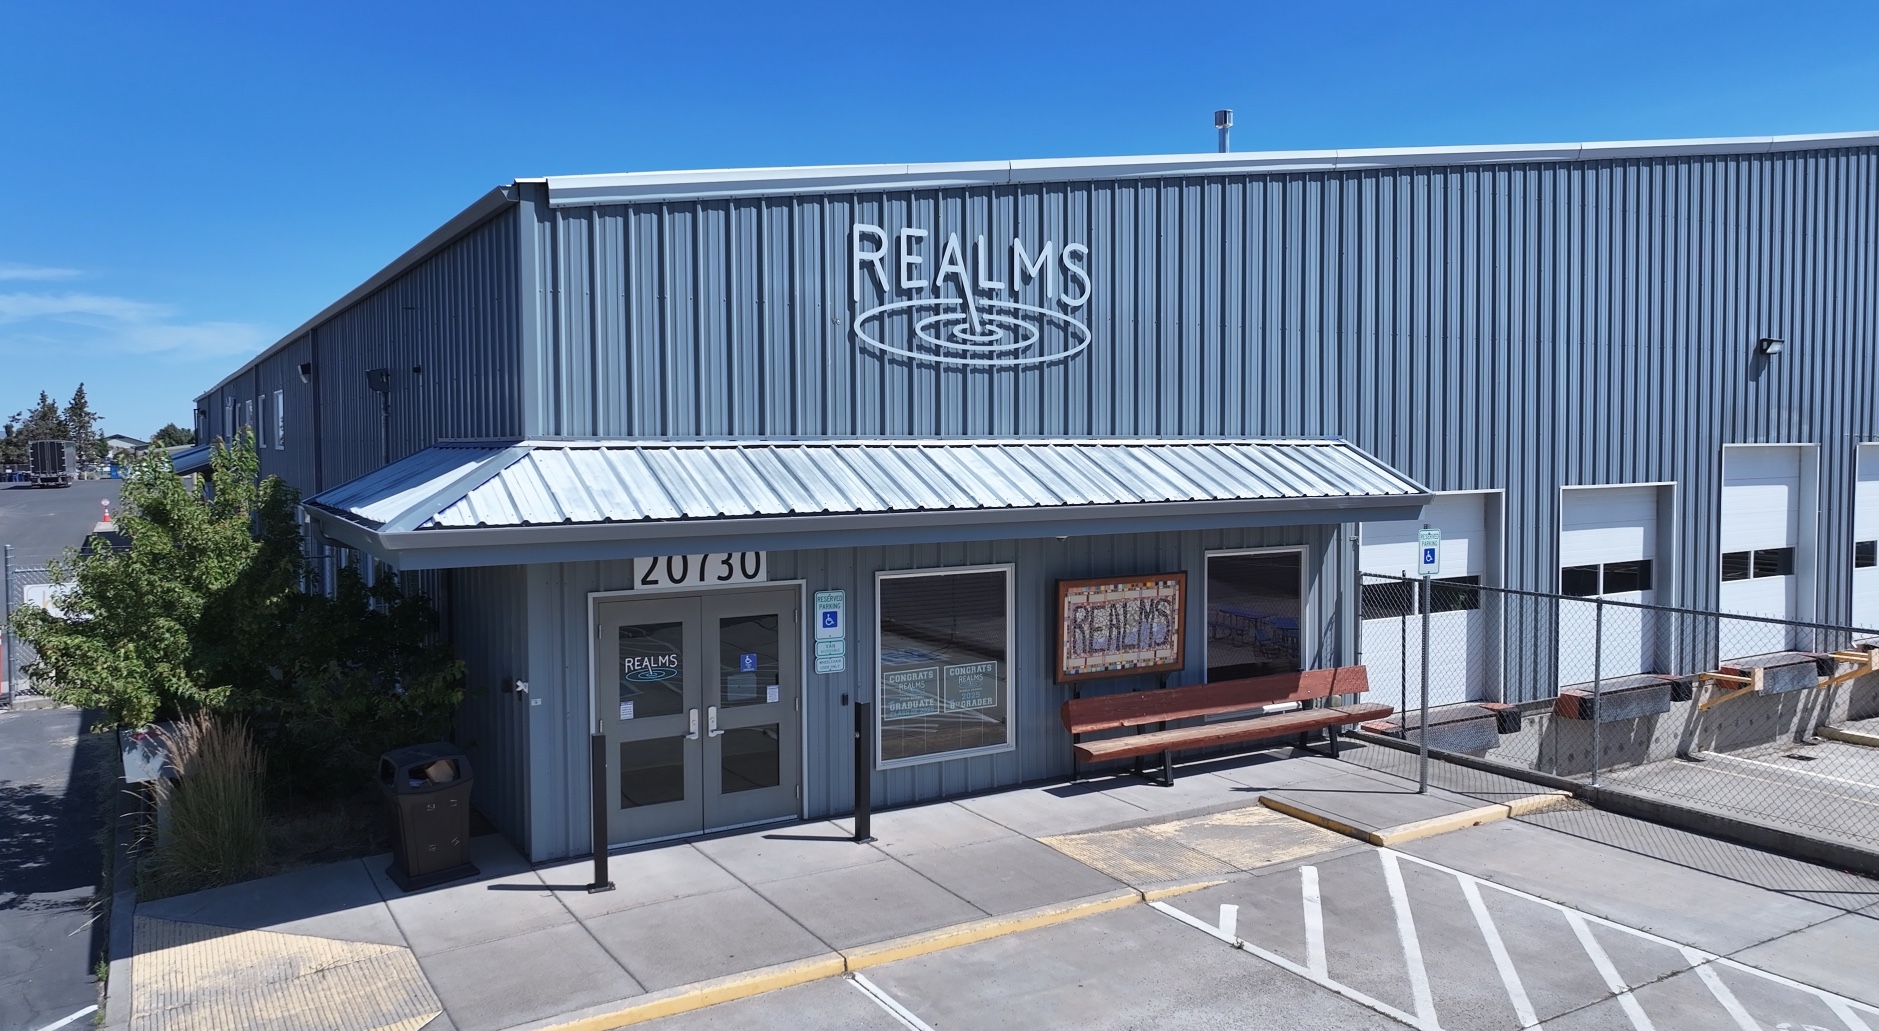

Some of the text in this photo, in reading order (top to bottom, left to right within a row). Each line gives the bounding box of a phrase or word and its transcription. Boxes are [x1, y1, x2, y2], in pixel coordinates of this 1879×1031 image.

[853, 223, 1091, 332] REALMS
[641, 551, 761, 585] 20730
[1073, 599, 1171, 654] REALMS
[625, 654, 678, 675] REALMS
[949, 664, 992, 676] CONGRATS
[890, 671, 934, 683] CONGRATS
[958, 673, 984, 685] REALMS
[899, 680, 926, 692] REALMS
[961, 691, 981, 700] 2025
[889, 698, 935, 711] GRADUATE
[961, 697, 993, 709] GRADER
